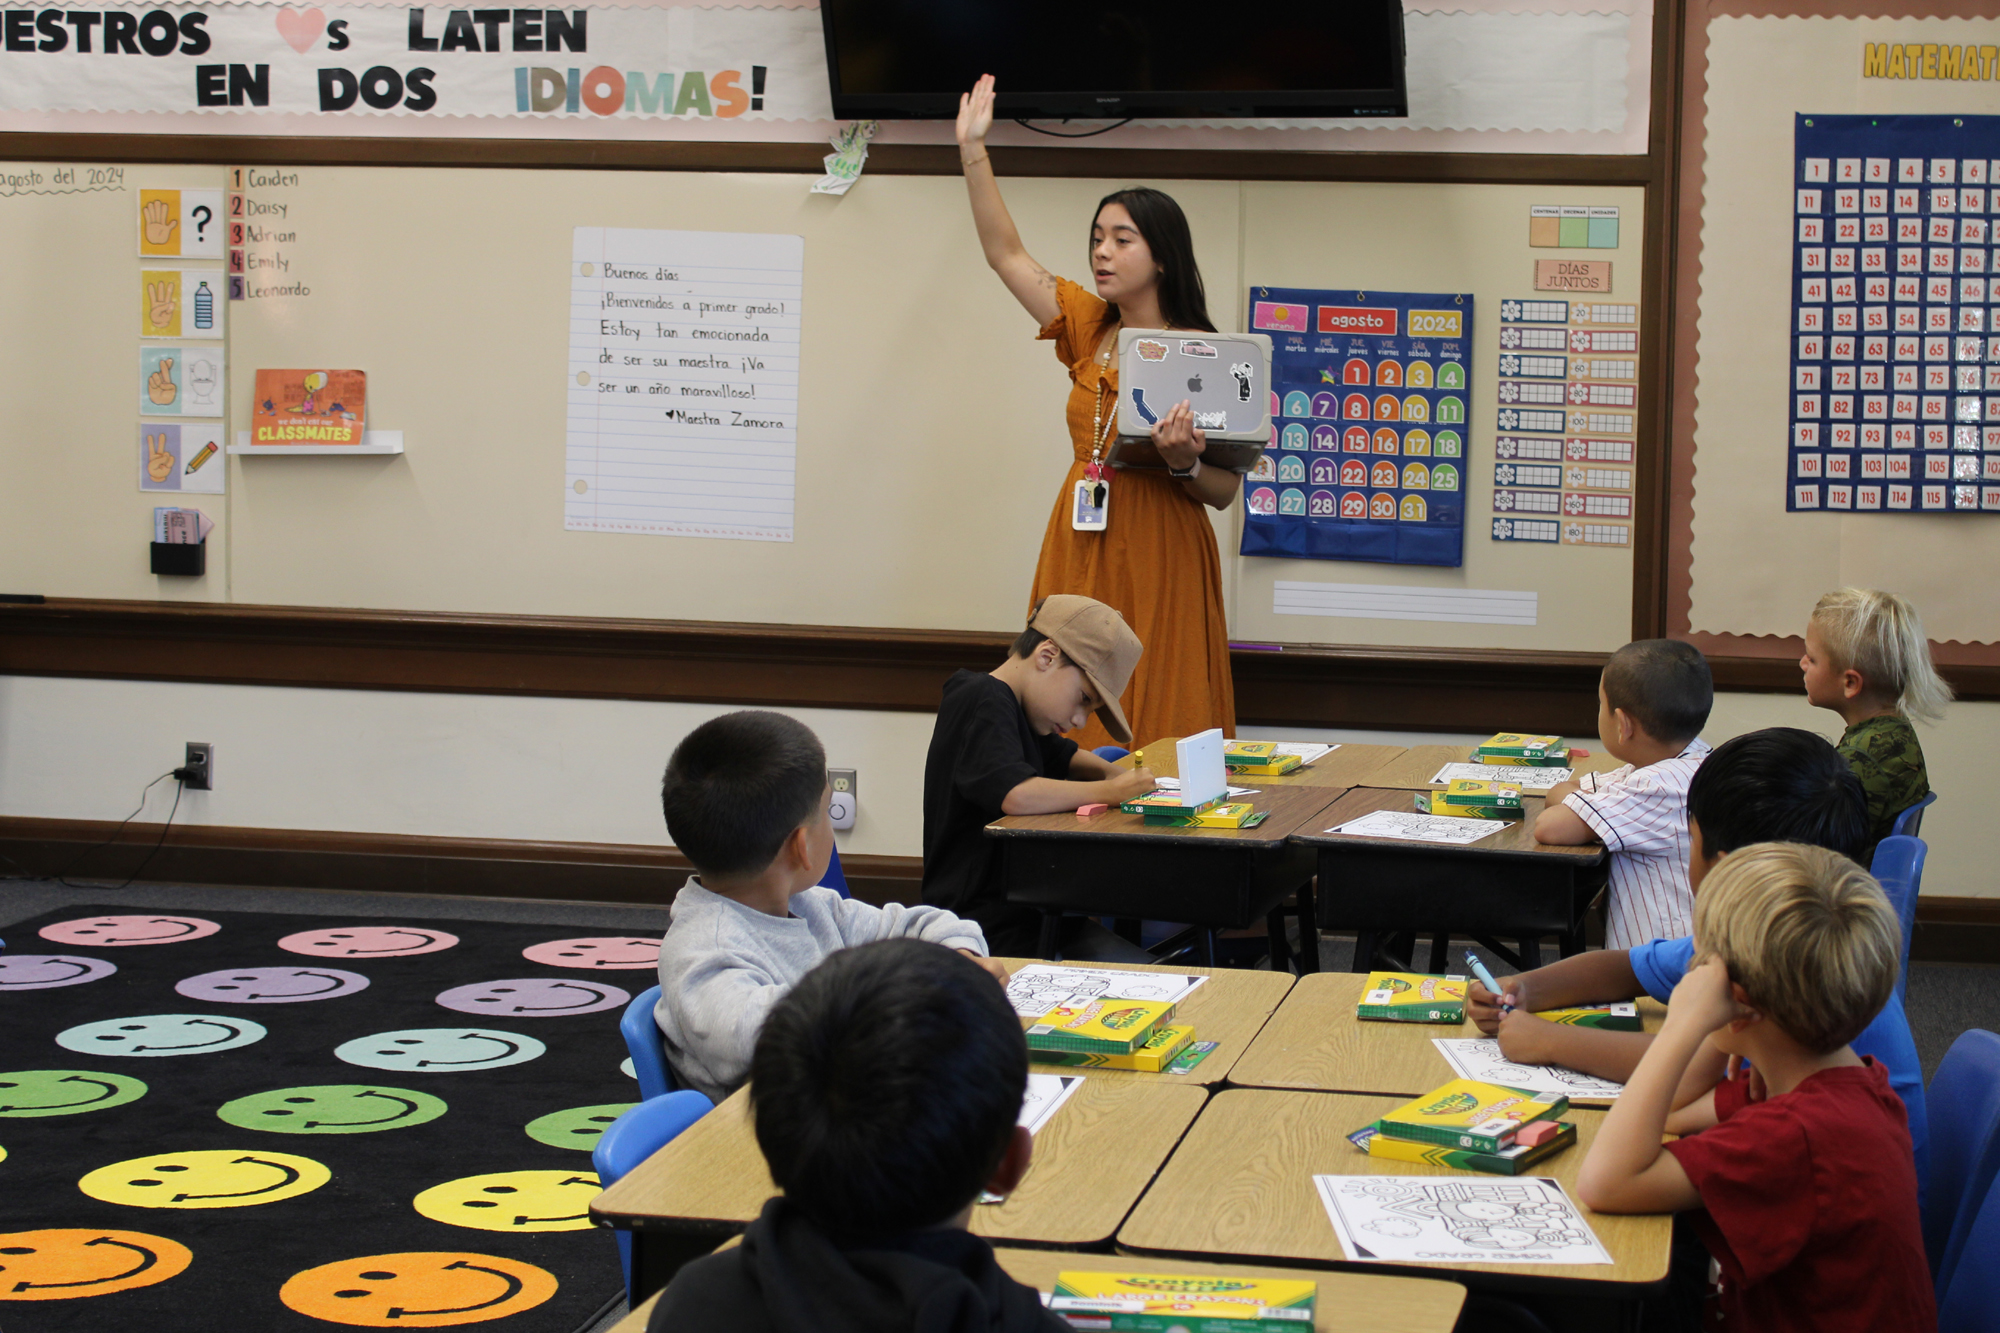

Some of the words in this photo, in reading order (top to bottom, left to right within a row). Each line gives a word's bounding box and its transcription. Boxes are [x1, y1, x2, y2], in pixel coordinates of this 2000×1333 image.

[0, 9, 211, 57] ESTROS
[408, 8, 587, 53] LATEN
[196, 64, 270, 107] EN
[317, 65, 437, 112] DOS
[514, 65, 767, 119] IDIOMAS!
[53, 168, 75, 185] del
[87, 167, 124, 185] 2024
[233, 170, 241, 188] 1
[249, 169, 299, 188] Caiden
[1814, 165, 1819, 177] 1
[1844, 164, 1852, 178] 2
[1872, 164, 1881, 178] 3
[1906, 165, 1915, 177] 4
[1939, 165, 1946, 178] 5
[232, 196, 242, 216] 2
[246, 198, 288, 219] Daisy
[1804, 196, 1814, 208] 11
[1841, 195, 1854, 208] 12
[1869, 195, 1882, 209] 13
[1899, 195, 1913, 208] 14
[1936, 195, 1949, 208] 15
[233, 224, 242, 243] 3
[246, 225, 296, 243] Adrian
[1804, 224, 1817, 238] 21
[1840, 224, 1855, 237] 22
[1869, 223, 1884, 237] 23
[1901, 224, 1917, 238] 24
[1933, 224, 1949, 238] 25
[231, 252, 242, 270] 4
[247, 253, 289, 272] Emily
[1807, 253, 1820, 267] 31
[1834, 254, 1850, 267] 32
[1866, 253, 1881, 267] 33
[1900, 254, 1917, 267] 34
[1933, 254, 1949, 267] 35
[604, 262, 648, 280] Buenos
[232, 279, 242, 297] 5
[247, 281, 310, 298] Leonardo
[1547, 276, 1599, 289] JUNTOS
[1807, 285, 1821, 297] 41
[1835, 284, 1852, 297] 42
[1869, 284, 1885, 297] 43
[1898, 284, 1916, 296] 44
[1931, 284, 1947, 297] 45
[699, 302, 738, 318] primer
[745, 302, 785, 320] grado!
[1507, 307, 1515, 315] 10
[1575, 309, 1586, 317] 20
[1265, 321, 1295, 330] verano
[1331, 314, 1384, 328] agosto
[1412, 315, 1458, 332] 2024
[1804, 314, 1817, 327] 51
[1837, 313, 1852, 327] 52
[1868, 312, 1883, 327] 53
[1899, 314, 1915, 326] 54
[1931, 314, 1946, 327] 55
[601, 319, 641, 341] Estoy
[656, 322, 678, 338] tan
[692, 327, 770, 342] emocionada
[1506, 334, 1516, 342] 30
[1575, 336, 1586, 345] 40
[1285, 344, 1307, 353] martes
[1347, 346, 1368, 357] jueves
[1804, 342, 1817, 355] 61
[1834, 342, 1851, 356] 62
[1868, 343, 1883, 356] 63
[1898, 343, 1915, 356] 64
[1929, 343, 1944, 356] 65
[599, 348, 614, 364] de
[624, 355, 643, 366] ser
[653, 357, 668, 367] su
[679, 354, 729, 369] maestra
[1505, 361, 1516, 370] 50
[1353, 368, 1360, 382] 1
[1385, 369, 1394, 383] 2
[1415, 370, 1425, 384] 3
[1445, 372, 1457, 385] 4
[1575, 365, 1585, 373] 60
[598, 382, 617, 393] ser
[626, 384, 640, 394] un
[648, 382, 671, 395] año
[681, 384, 756, 400] maravilloso!
[1505, 388, 1514, 396] 70
[1574, 390, 1583, 398] 80
[1292, 400, 1302, 414] 6
[1320, 401, 1329, 415] 7
[1351, 403, 1361, 417] 8
[1381, 404, 1391, 417] 9
[1407, 404, 1425, 419] 10
[1441, 406, 1457, 420] 11
[675, 410, 721, 426] Maestra
[731, 411, 785, 429] Zamora
[258, 426, 352, 441] CLASSMATES
[1287, 432, 1303, 447] 13
[1316, 434, 1334, 448] 14
[1349, 435, 1365, 450] 15
[1377, 437, 1394, 451] 16
[1410, 439, 1426, 453] 17
[1440, 440, 1456, 454] 18
[1281, 465, 1301, 479] 20
[1315, 467, 1332, 481] 21
[1344, 469, 1364, 483] 22
[1374, 470, 1394, 484] 23
[1406, 472, 1426, 486] 24
[1435, 473, 1455, 487] 25
[1254, 497, 1273, 511] 26
[1283, 497, 1302, 512] 27
[1313, 499, 1332, 513] 28
[1344, 501, 1363, 515] 29
[1373, 502, 1393, 516] 30
[1404, 504, 1423, 517] 31
[1128, 1277, 1243, 1288] Crayola
